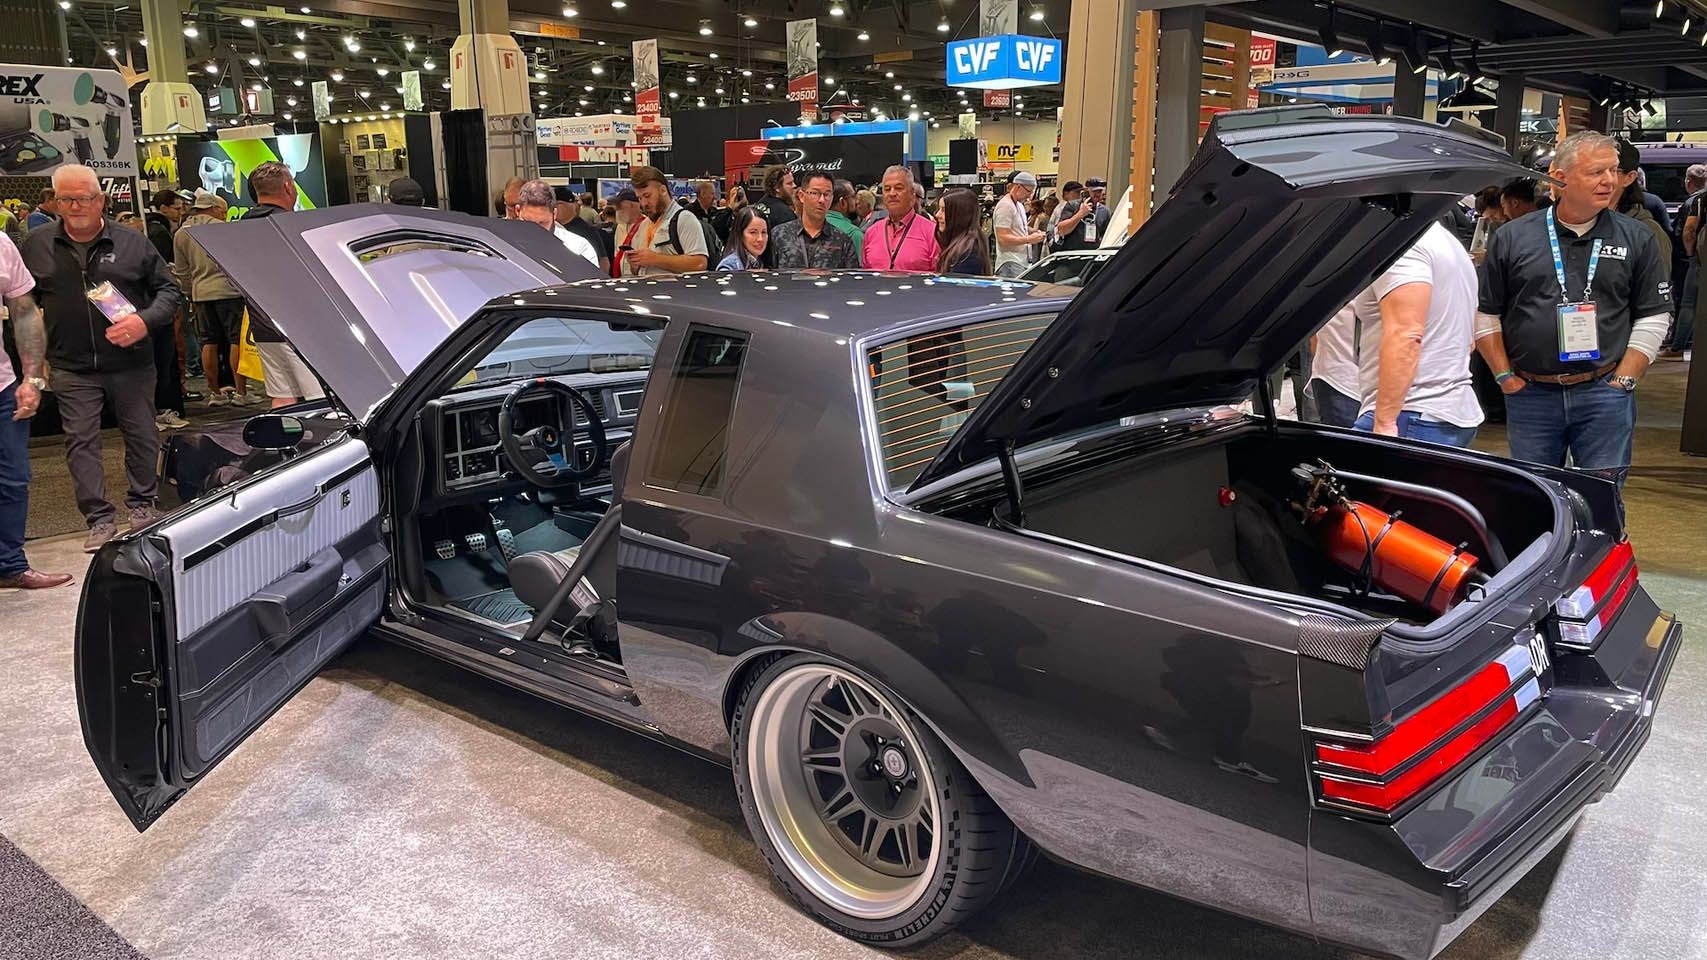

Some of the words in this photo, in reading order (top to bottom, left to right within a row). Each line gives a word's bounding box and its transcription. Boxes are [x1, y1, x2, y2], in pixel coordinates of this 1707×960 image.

[954, 41, 1001, 75] CVF
[1016, 41, 1055, 74] CVF
[789, 90, 816, 101] 23500
[637, 103, 658, 113] 23400
[642, 135, 663, 143] 23400
[997, 145, 1021, 157] MF
[86, 160, 131, 169] AOS368K
[894, 888, 947, 940] MICHELIN
